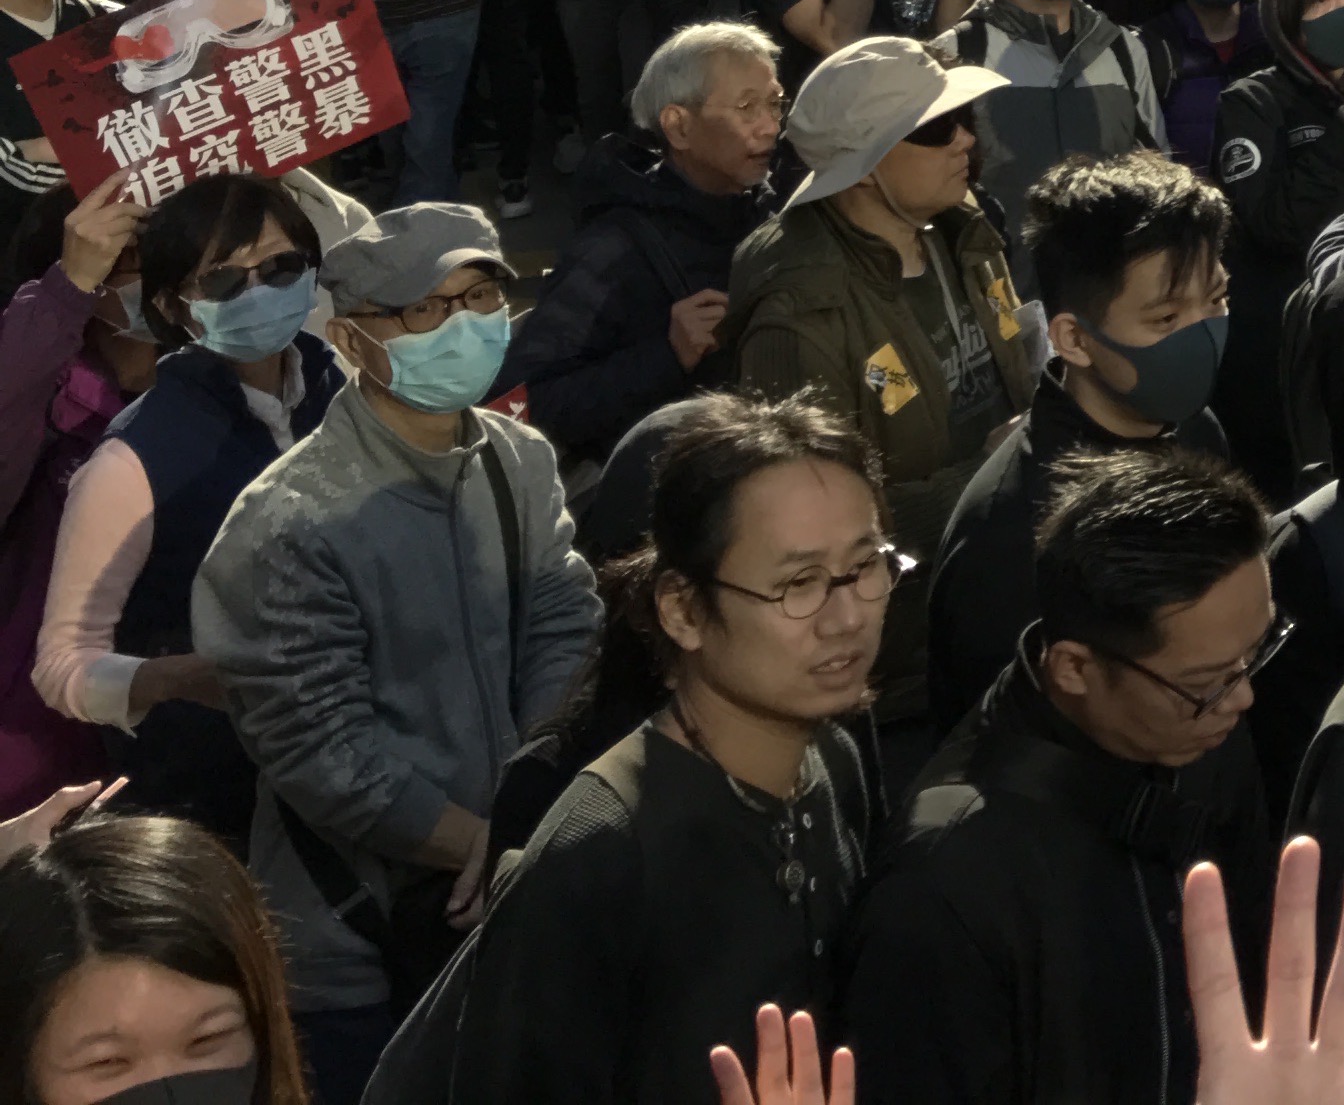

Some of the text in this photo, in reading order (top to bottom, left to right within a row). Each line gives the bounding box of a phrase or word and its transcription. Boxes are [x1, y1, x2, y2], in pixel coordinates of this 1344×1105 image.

[96, 21, 357, 169] 徹查警黑
[122, 76, 371, 208] 追究警暴
